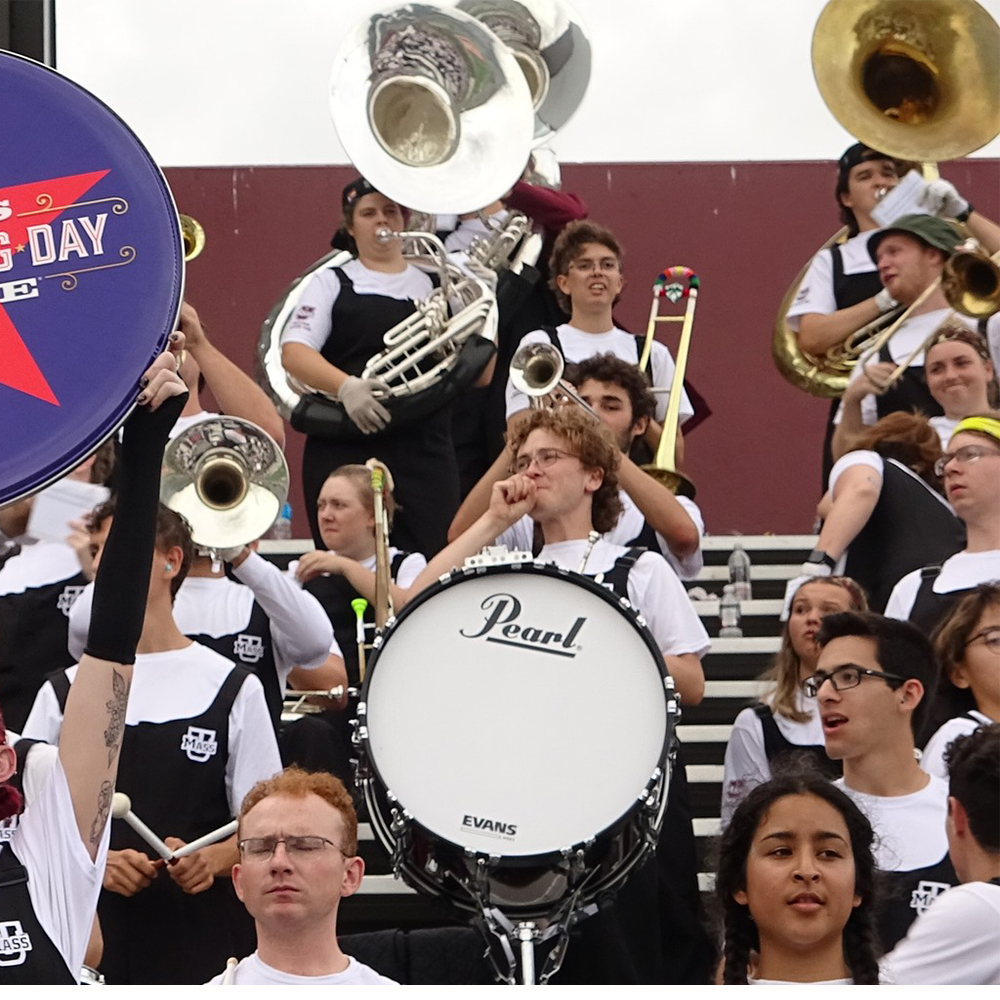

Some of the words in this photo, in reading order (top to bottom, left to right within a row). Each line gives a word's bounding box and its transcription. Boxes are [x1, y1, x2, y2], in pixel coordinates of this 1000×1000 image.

[26, 213, 109, 266] DAY
[460, 593, 587, 648] Pearl
[462, 815, 518, 836] EVANS
